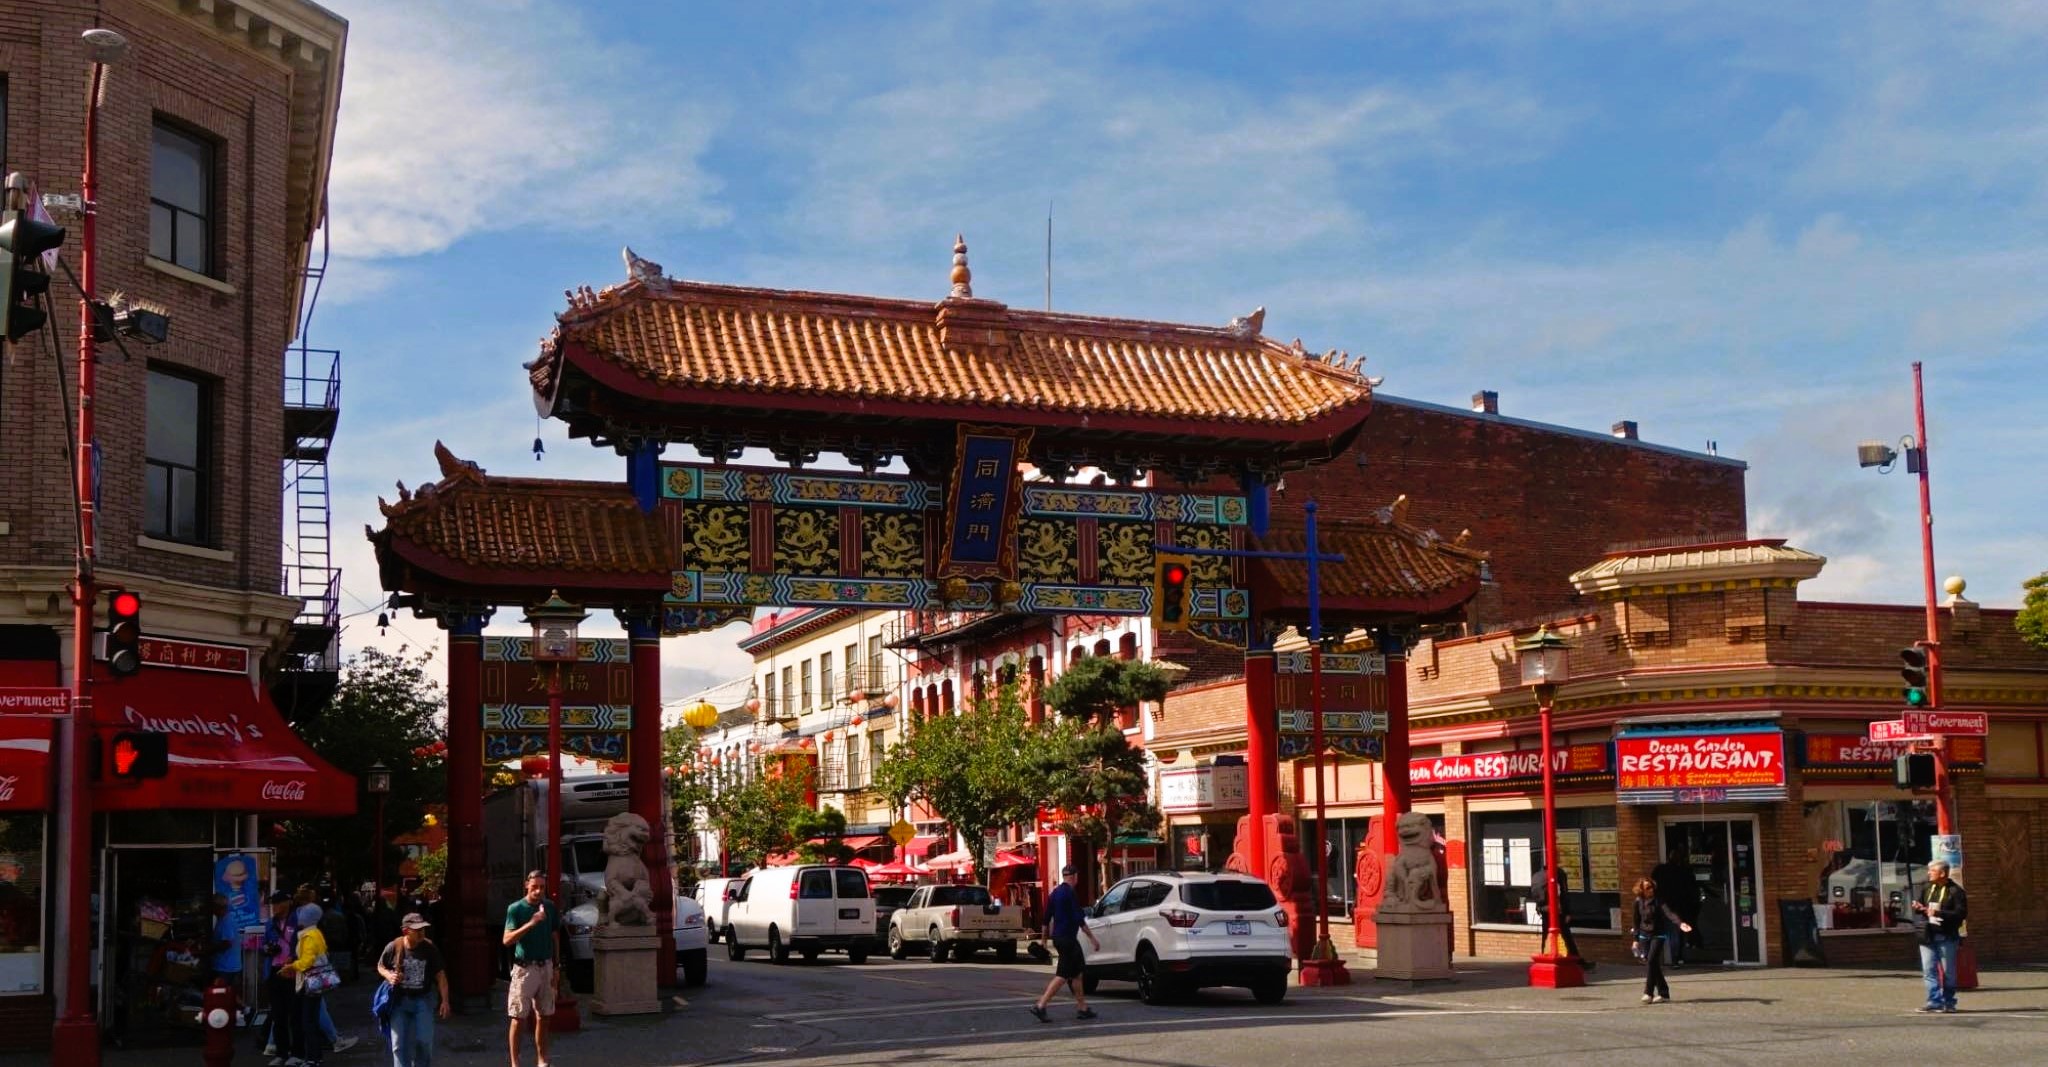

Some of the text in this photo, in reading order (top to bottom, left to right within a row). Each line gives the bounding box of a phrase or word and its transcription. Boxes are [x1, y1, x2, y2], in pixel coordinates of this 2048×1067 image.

[0, 692, 67, 707] vernment
[1928, 714, 1984, 728] Government
[1649, 738, 1746, 754] Ocean Garden
[1409, 767, 1431, 781] cean
[1433, 757, 1472, 780] Garden
[1621, 750, 1775, 773] RESTAURANT
